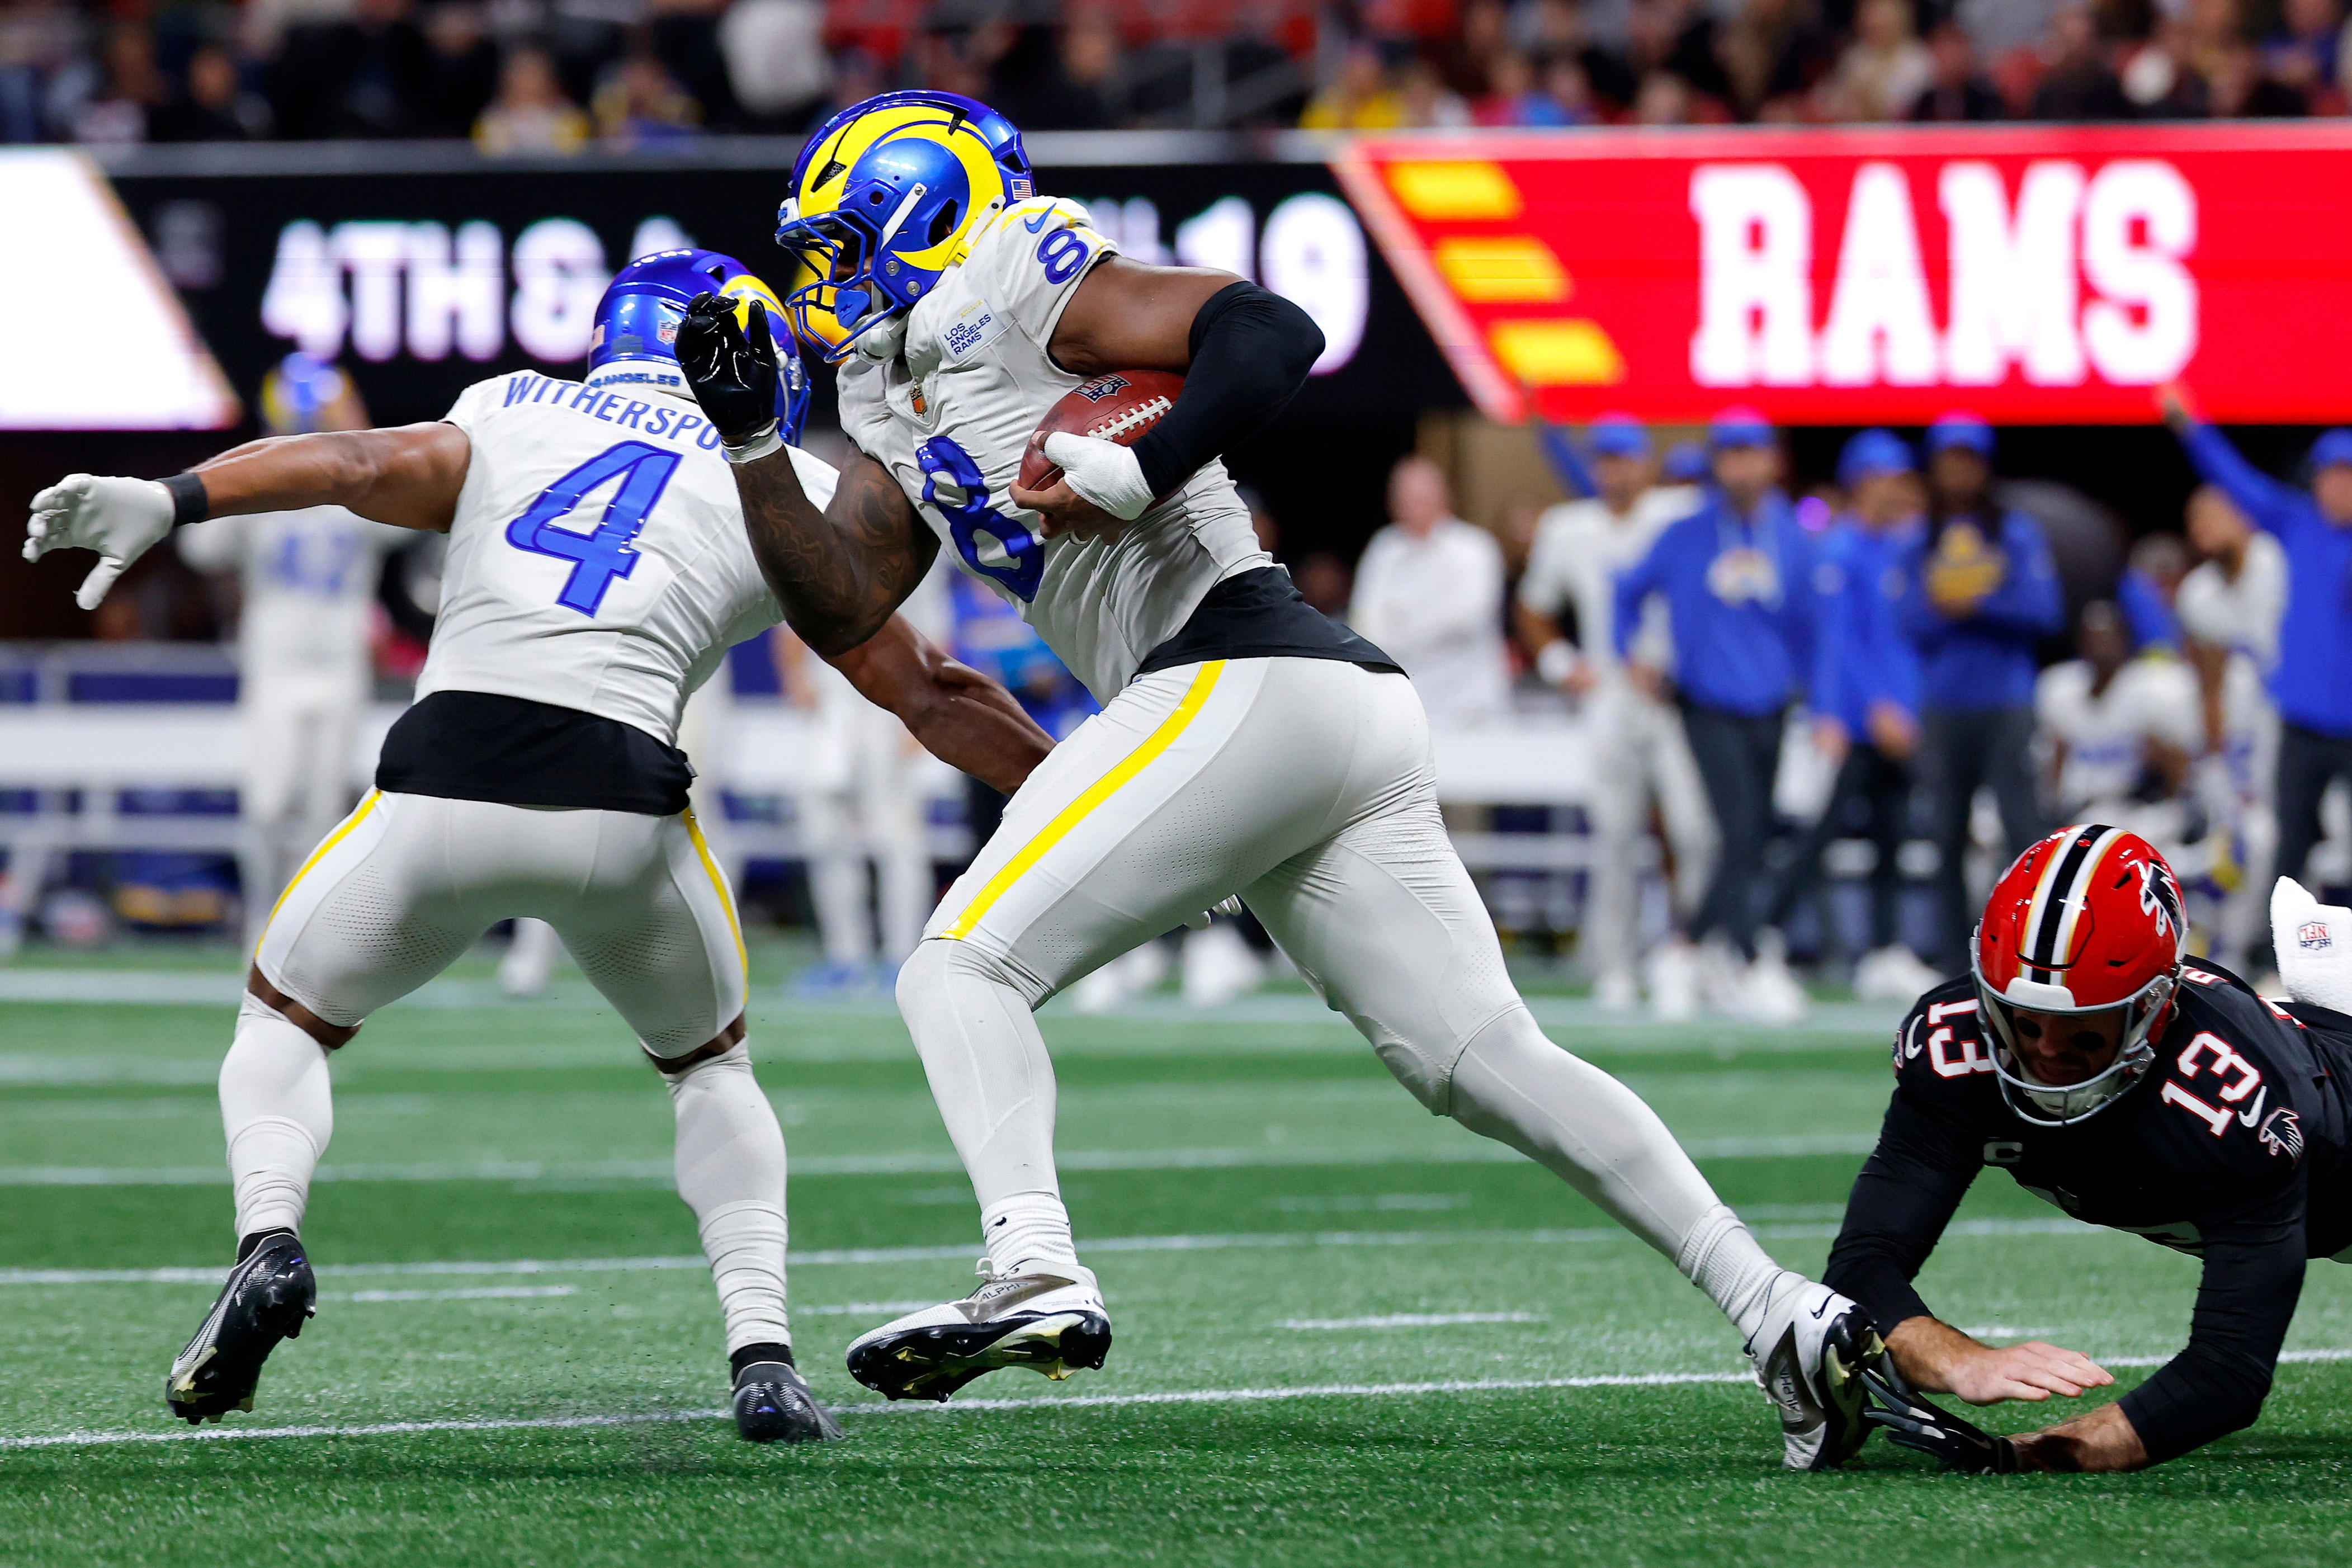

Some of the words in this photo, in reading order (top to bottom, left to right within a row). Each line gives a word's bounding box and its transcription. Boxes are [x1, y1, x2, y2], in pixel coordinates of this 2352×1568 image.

[262, 219, 504, 362] 4TH
[1037, 230, 1088, 284] 8
[1688, 160, 2201, 388] RAMS
[944, 323, 965, 341] LOS
[950, 314, 991, 348] ANGELES
[953, 332, 982, 355] RAMS
[604, 372, 681, 387] ANGELES
[502, 376, 730, 461] WITHERSPO
[505, 440, 684, 618] 4
[915, 436, 1045, 603] 8
[2299, 925, 2327, 939] NFL
[1926, 997, 1996, 1079] 13
[2161, 1030, 2263, 1139] 13
[1983, 1141, 2023, 1163] C
